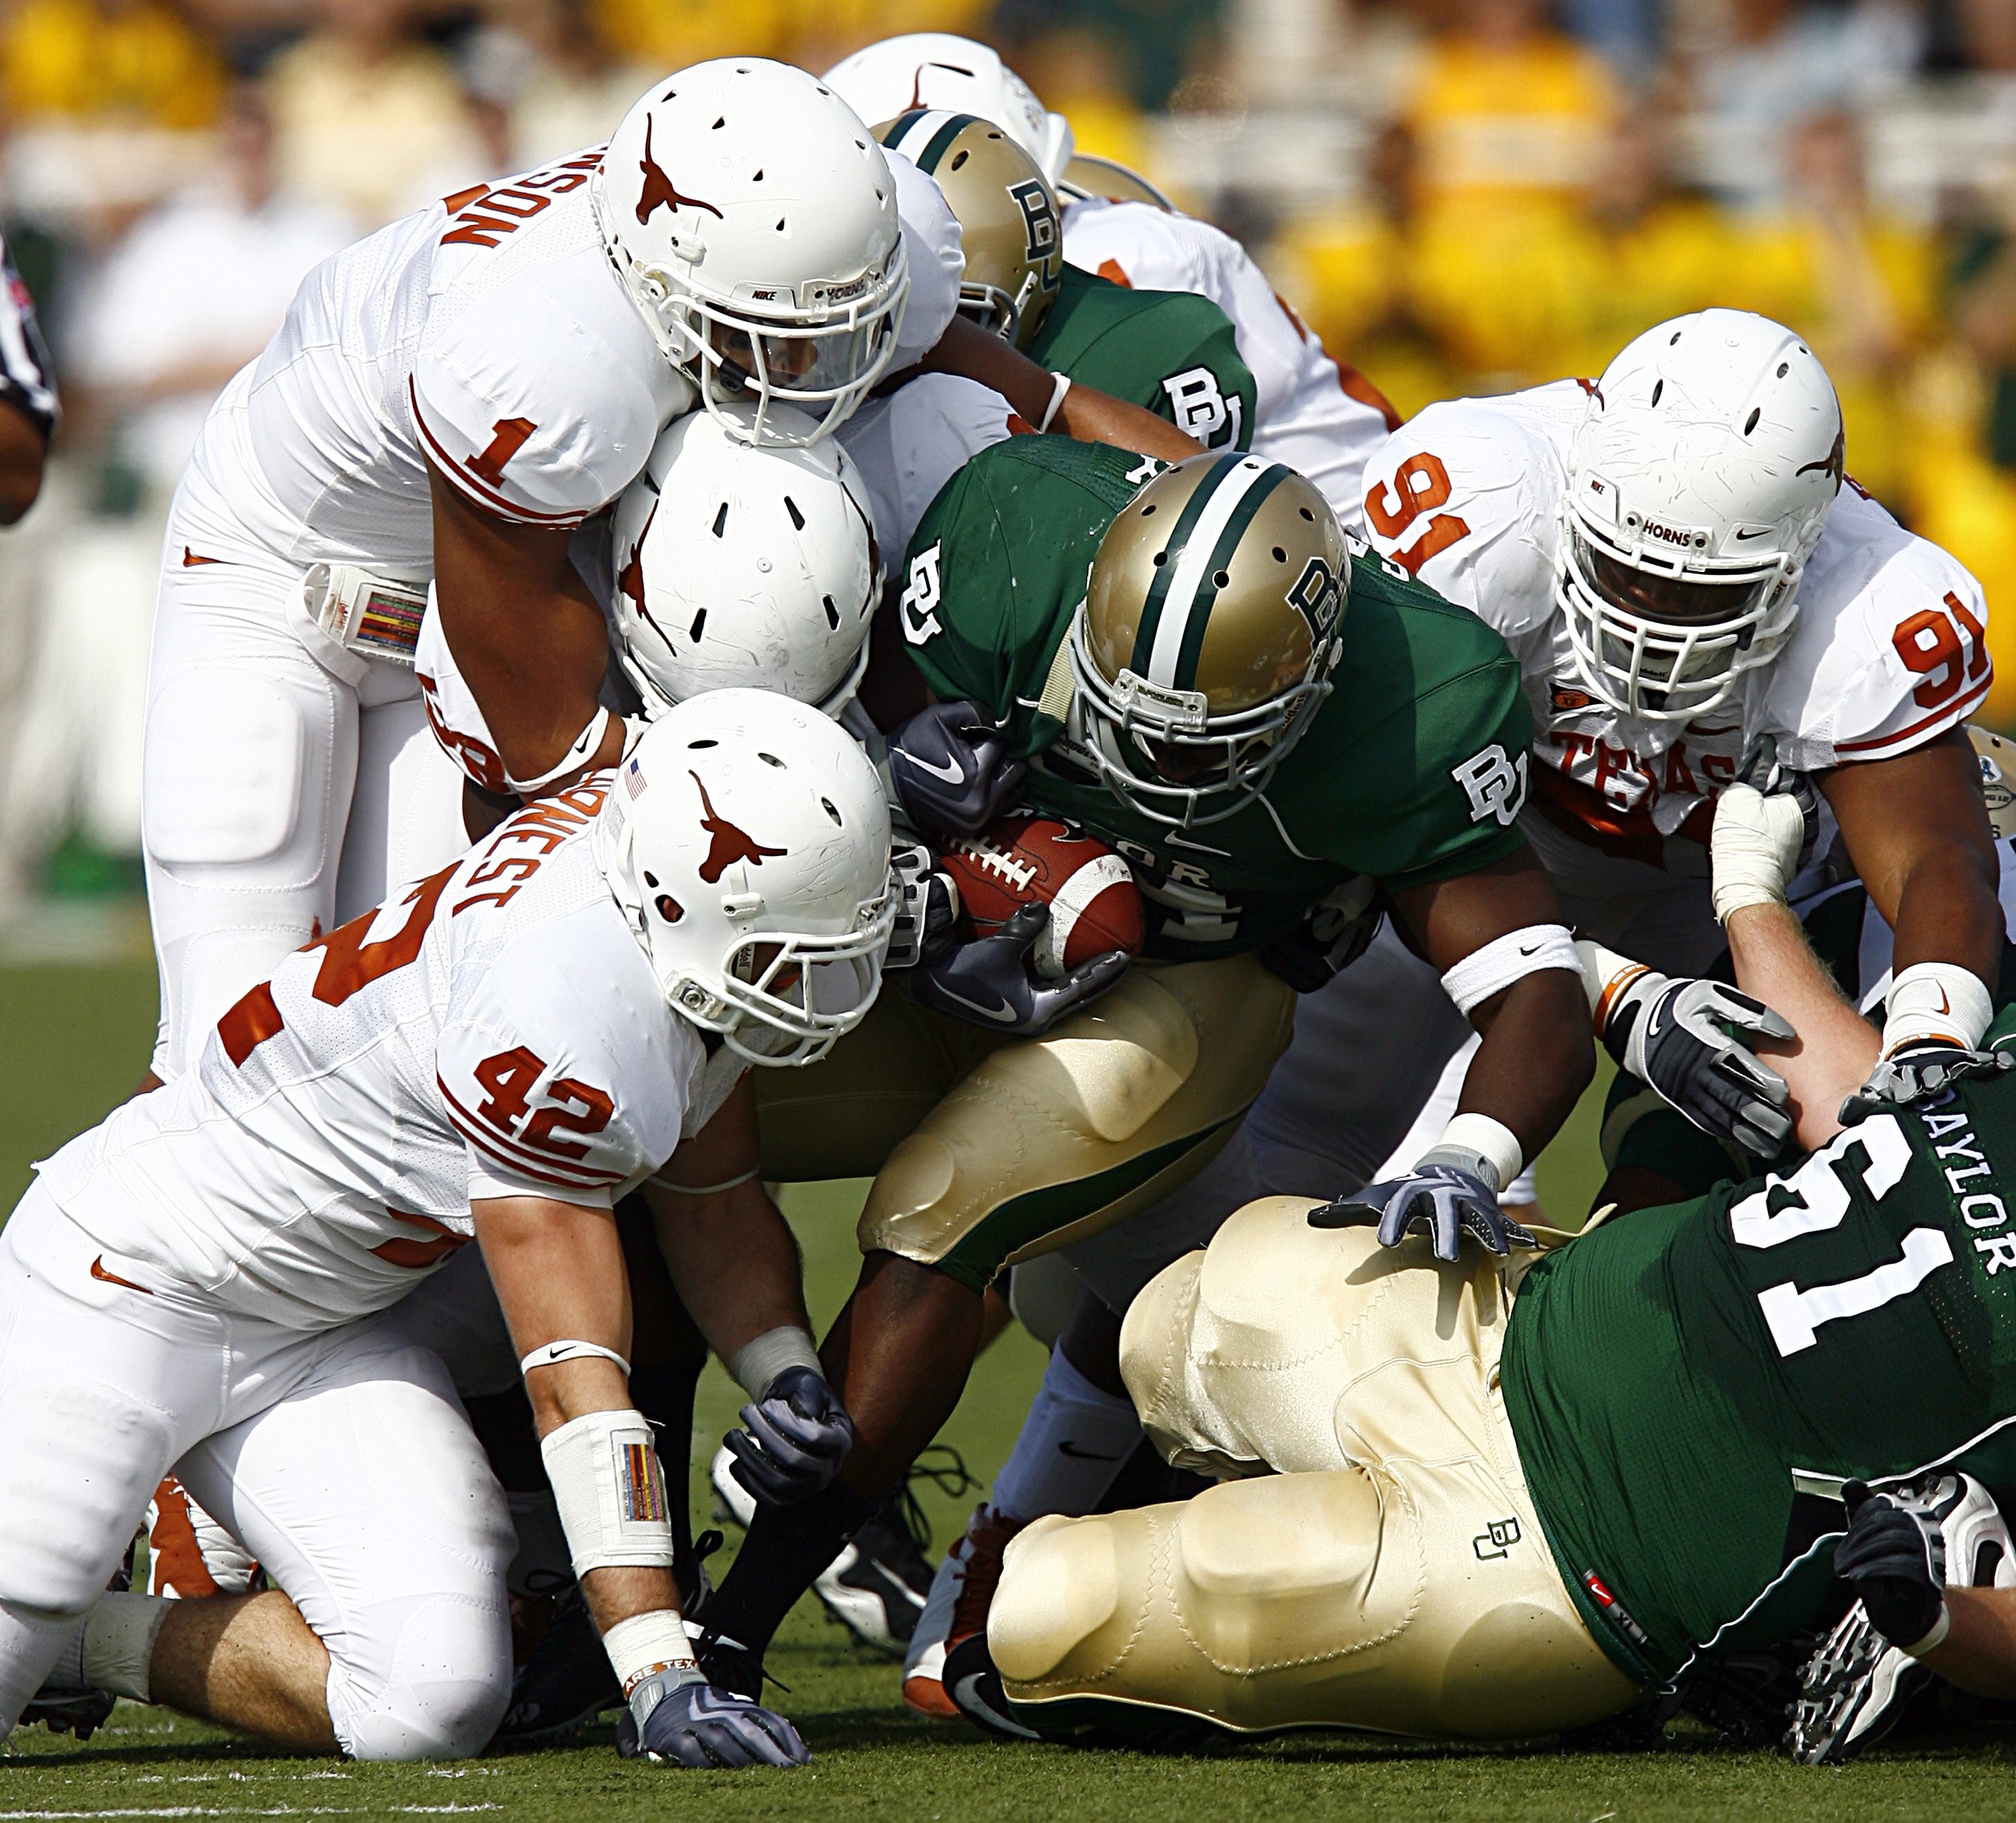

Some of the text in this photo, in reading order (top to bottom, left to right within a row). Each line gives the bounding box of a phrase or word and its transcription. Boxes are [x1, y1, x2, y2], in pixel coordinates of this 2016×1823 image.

[439, 146, 609, 249] NSON
[751, 290, 777, 301] NIKE
[464, 417, 538, 489] 1
[1365, 451, 1472, 575] 91
[1643, 519, 1690, 547] HORNS
[1892, 591, 1989, 709] 91
[1452, 745, 1528, 826] BU
[1549, 730, 1737, 813] TEXAS
[473, 1045, 615, 1158] 42
[1729, 1113, 1955, 1358] 61
[1472, 1516, 1520, 1561] BU
[626, 1664, 657, 1693] ARE
